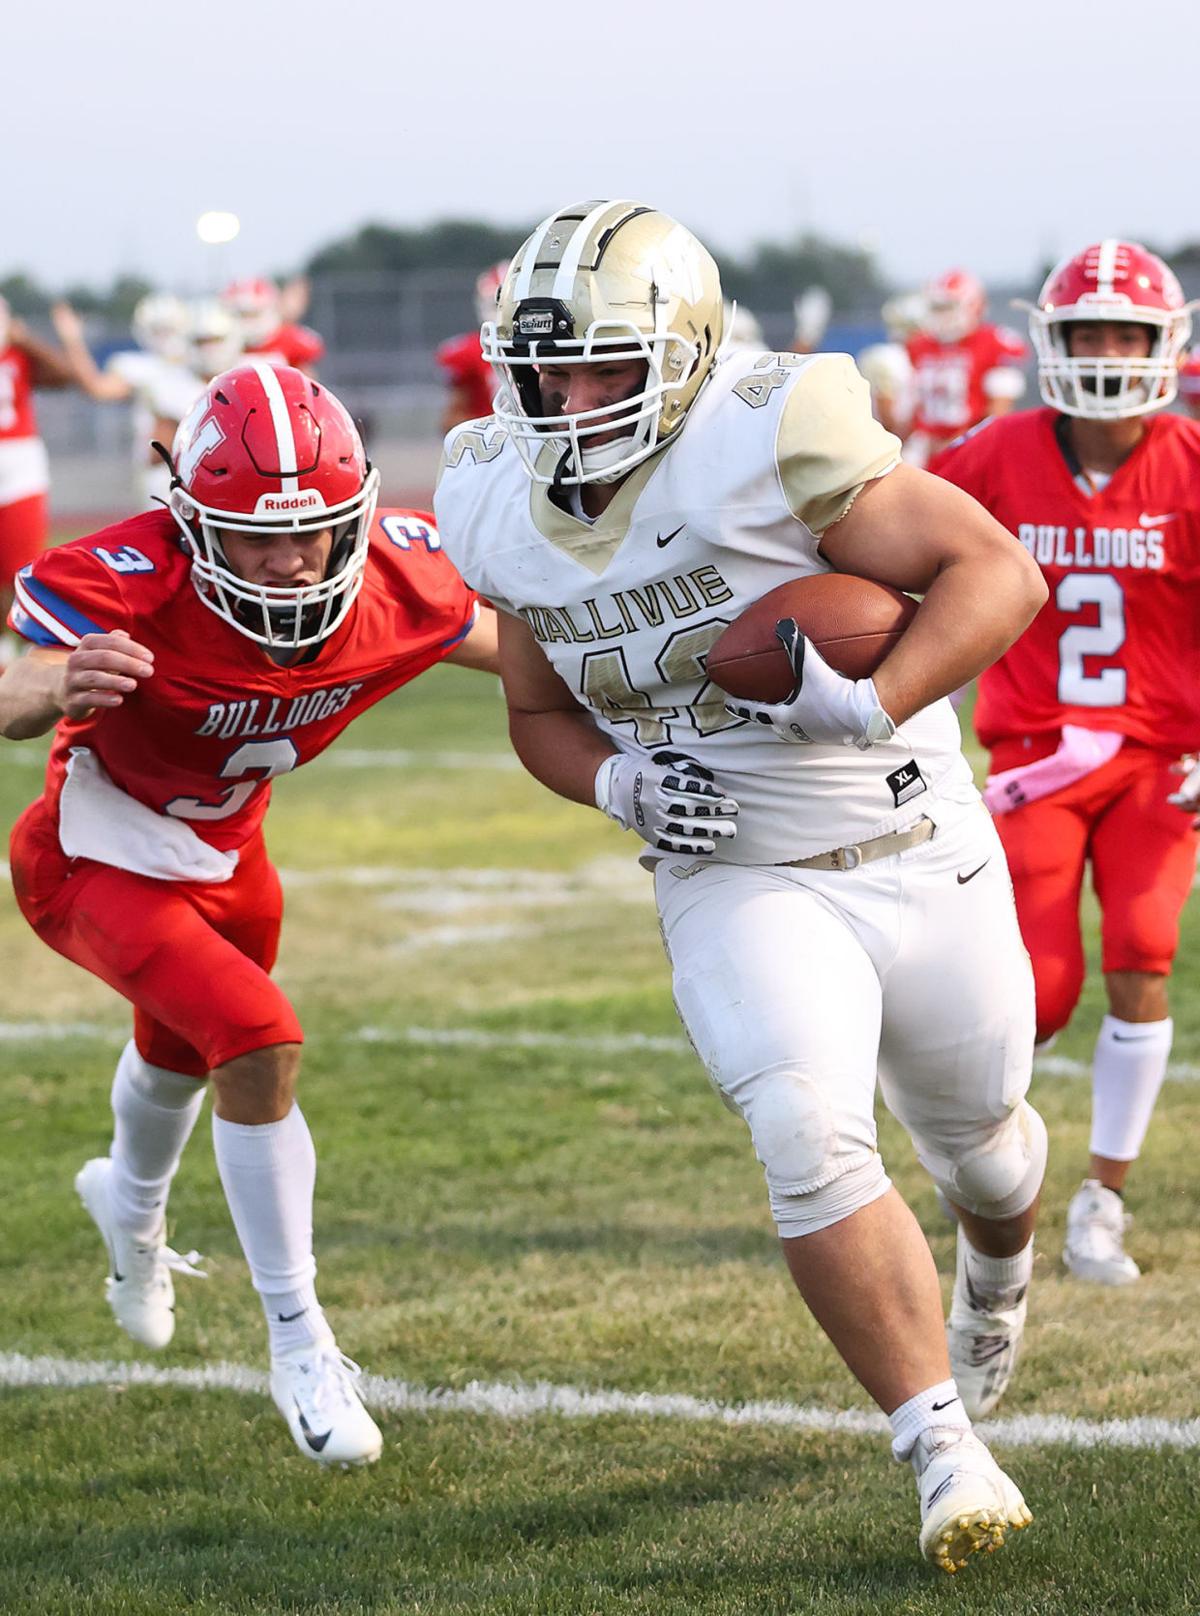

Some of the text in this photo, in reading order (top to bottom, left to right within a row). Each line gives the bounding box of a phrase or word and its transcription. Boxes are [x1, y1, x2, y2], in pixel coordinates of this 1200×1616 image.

[445, 415, 509, 468] 2
[264, 496, 317, 511] Riddell
[378, 515, 442, 553] 3
[1017, 522, 1165, 570] BULLDOGS
[92, 544, 156, 575] 3
[1055, 572, 1127, 708] 2
[194, 683, 364, 740] BULLDOGS
[163, 735, 299, 821] 3
[894, 770, 914, 787] XL
